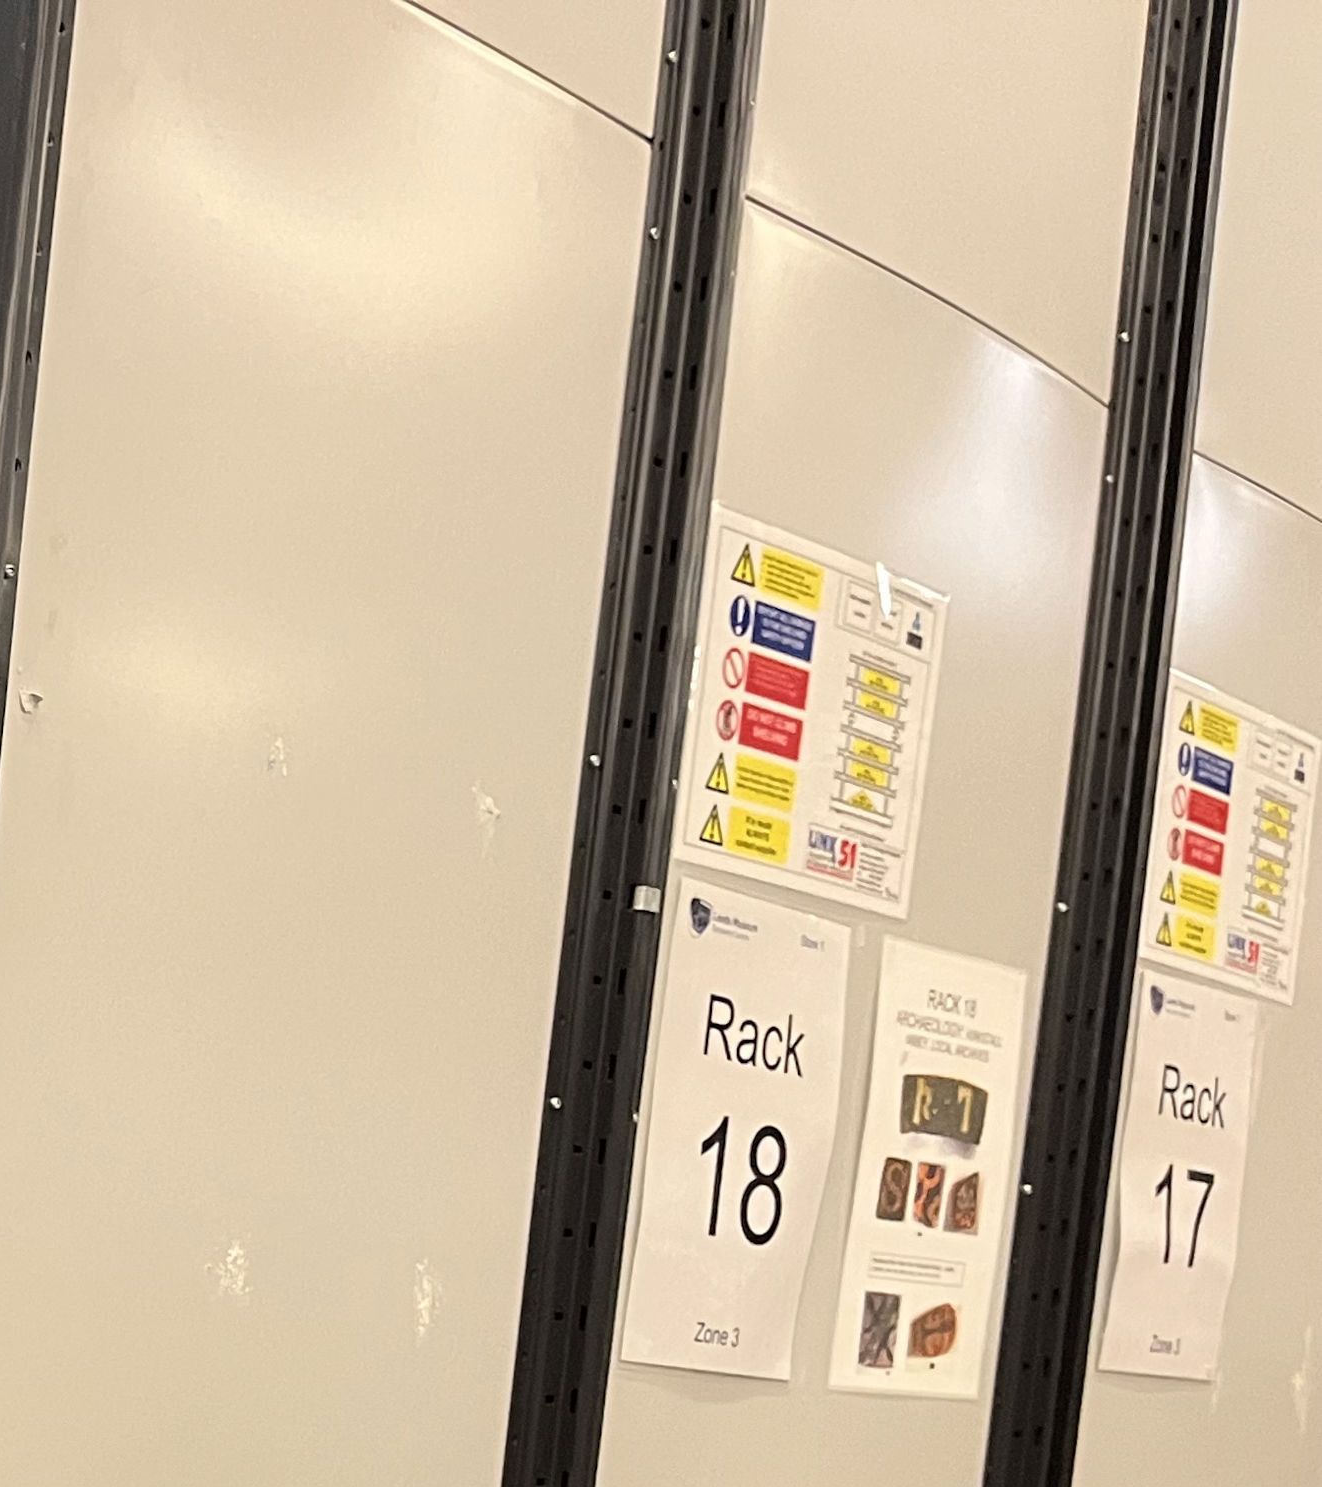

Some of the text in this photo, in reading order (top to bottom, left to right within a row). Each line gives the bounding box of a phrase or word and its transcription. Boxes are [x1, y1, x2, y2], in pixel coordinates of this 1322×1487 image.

[703, 993, 805, 1078] Rack
[926, 989, 962, 1015] RACK
[1158, 1064, 1227, 1129] Rack
[701, 1116, 787, 1245] 18
[1155, 1163, 1215, 1268] 17
[694, 1322, 740, 1348] Zone 3
